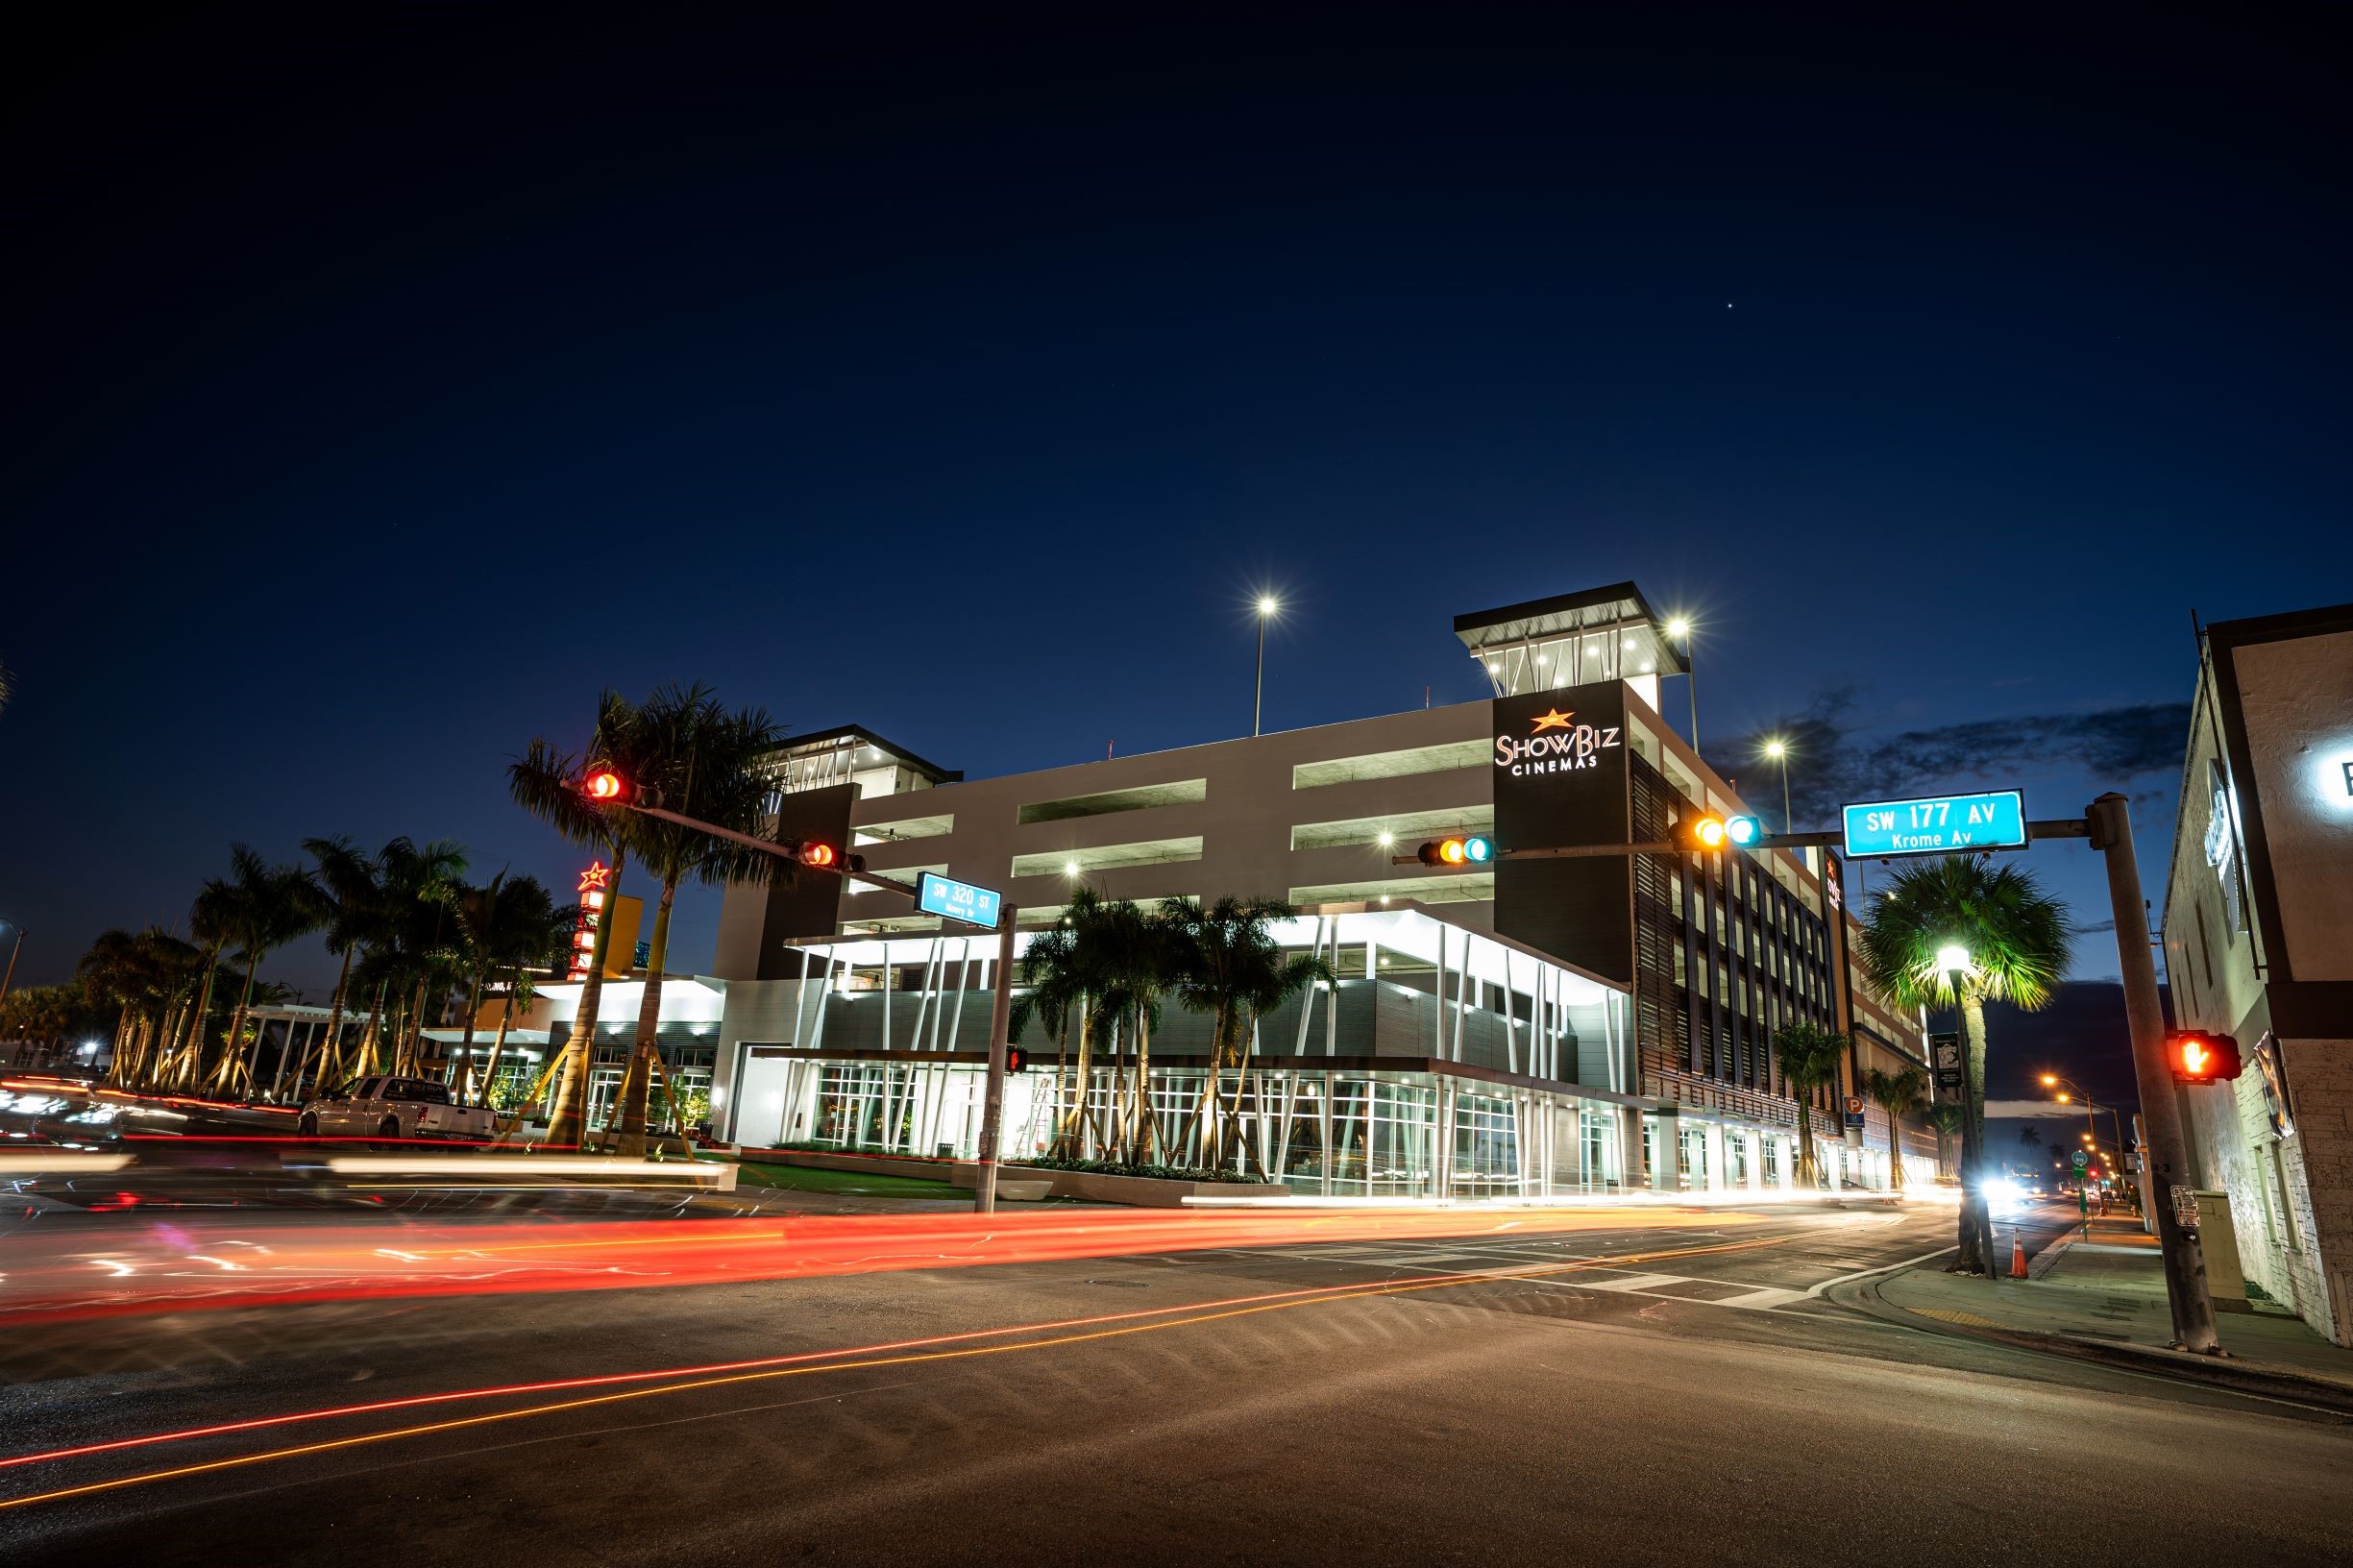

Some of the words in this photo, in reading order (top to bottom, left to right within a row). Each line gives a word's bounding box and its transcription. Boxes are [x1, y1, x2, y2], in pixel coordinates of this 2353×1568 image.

[1511, 755, 1597, 776] CINEMAS
[1867, 811, 1896, 832] SW
[1909, 802, 1950, 828] 177
[1968, 803, 1996, 824] AV
[1892, 834, 1943, 849] Krome
[1951, 830, 1972, 845] Av
[934, 884, 947, 898] SW
[952, 886, 973, 904] 320
[979, 895, 990, 909] ST
[1850, 1099, 1860, 1112] P
